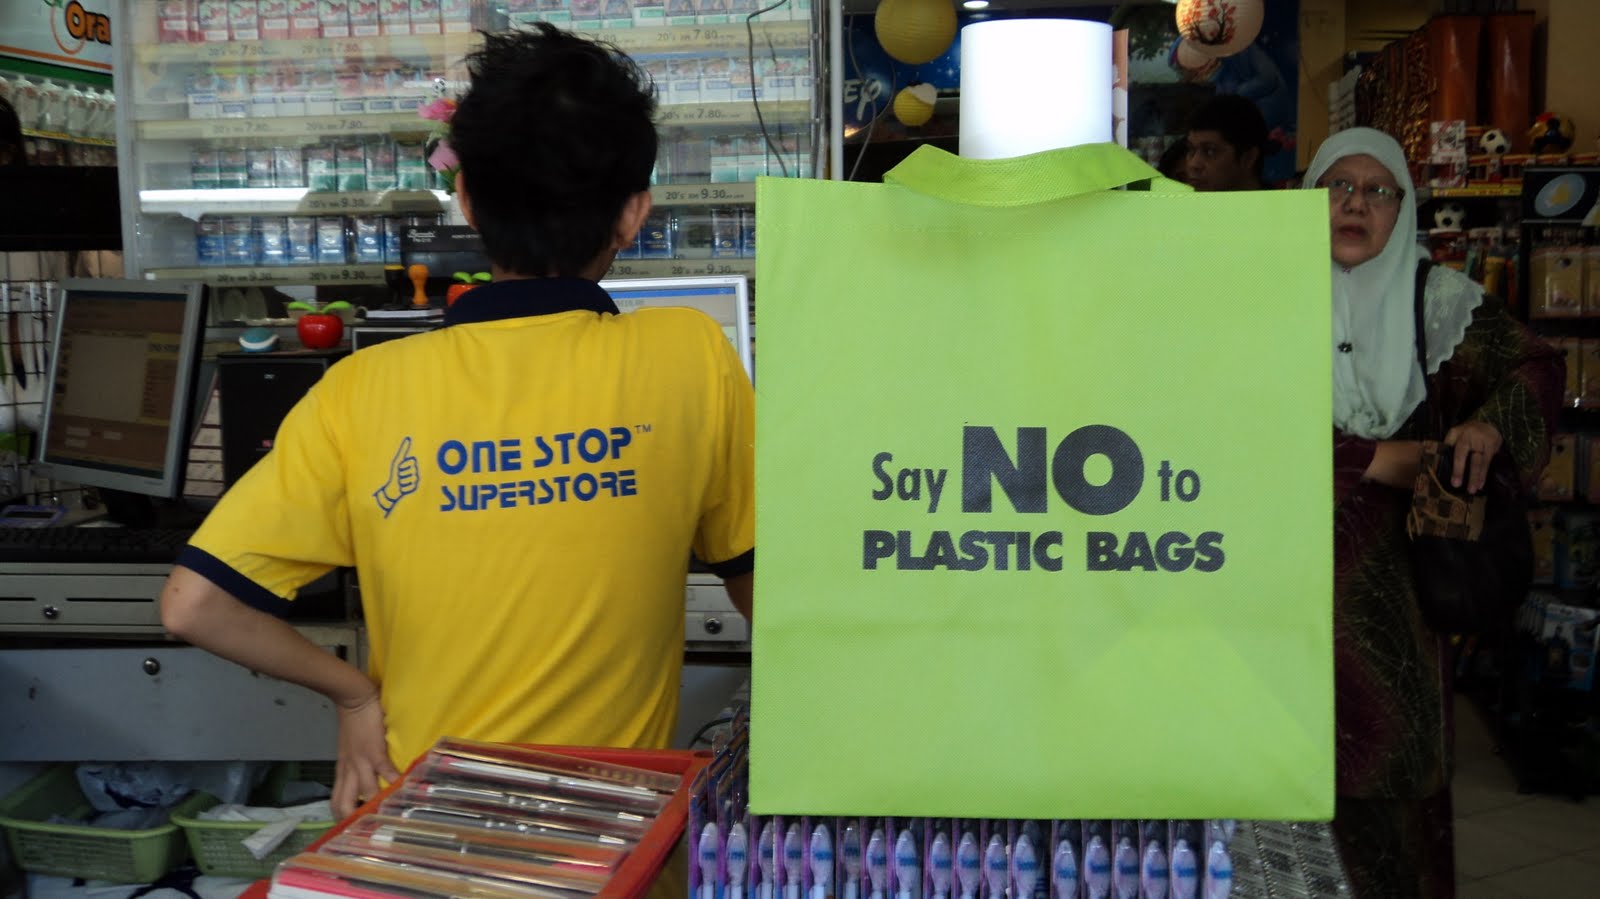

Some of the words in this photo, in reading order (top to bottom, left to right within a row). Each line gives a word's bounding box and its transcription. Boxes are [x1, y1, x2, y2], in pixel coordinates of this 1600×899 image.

[693, 30, 718, 41] 7.80
[696, 108, 721, 119] 7.80
[701, 188, 726, 199] 9.30
[341, 197, 365, 208] 9.30
[608, 265, 632, 275] 9.30
[707, 263, 732, 274] 9.30
[342, 269, 365, 280] 9.30
[437, 438, 522, 475] ONE
[533, 426, 632, 468] STOP
[871, 451, 948, 514] Say
[961, 424, 1145, 516] NO
[1157, 460, 1201, 503] to
[439, 469, 638, 512] SUPERSTORE
[862, 530, 1064, 572] PLASTIC
[1086, 531, 1225, 573] BAGS
